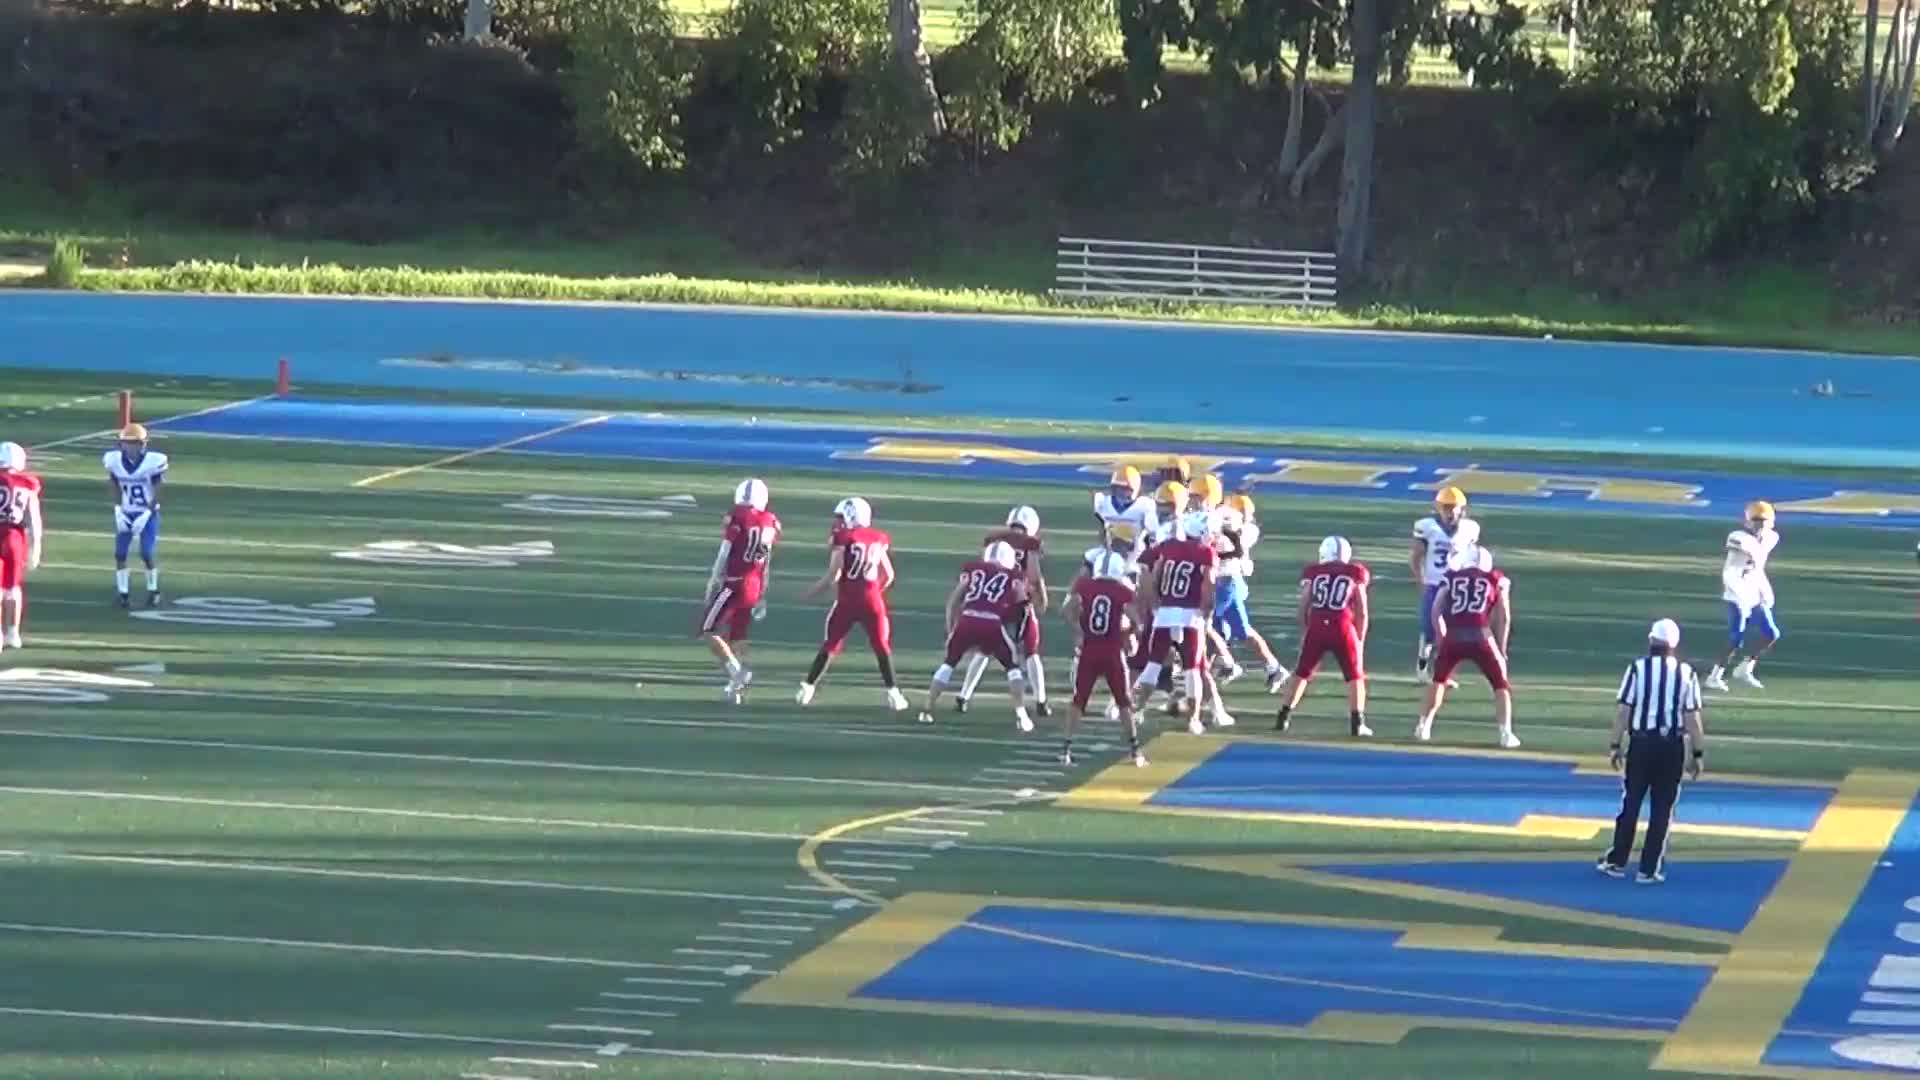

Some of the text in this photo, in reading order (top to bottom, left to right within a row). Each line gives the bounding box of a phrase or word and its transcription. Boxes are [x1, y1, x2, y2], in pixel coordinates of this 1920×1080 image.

[965, 569, 1008, 602] 34
[1161, 559, 1194, 598] 16
[1451, 577, 1490, 614] 53
[1089, 594, 1111, 634] 8
